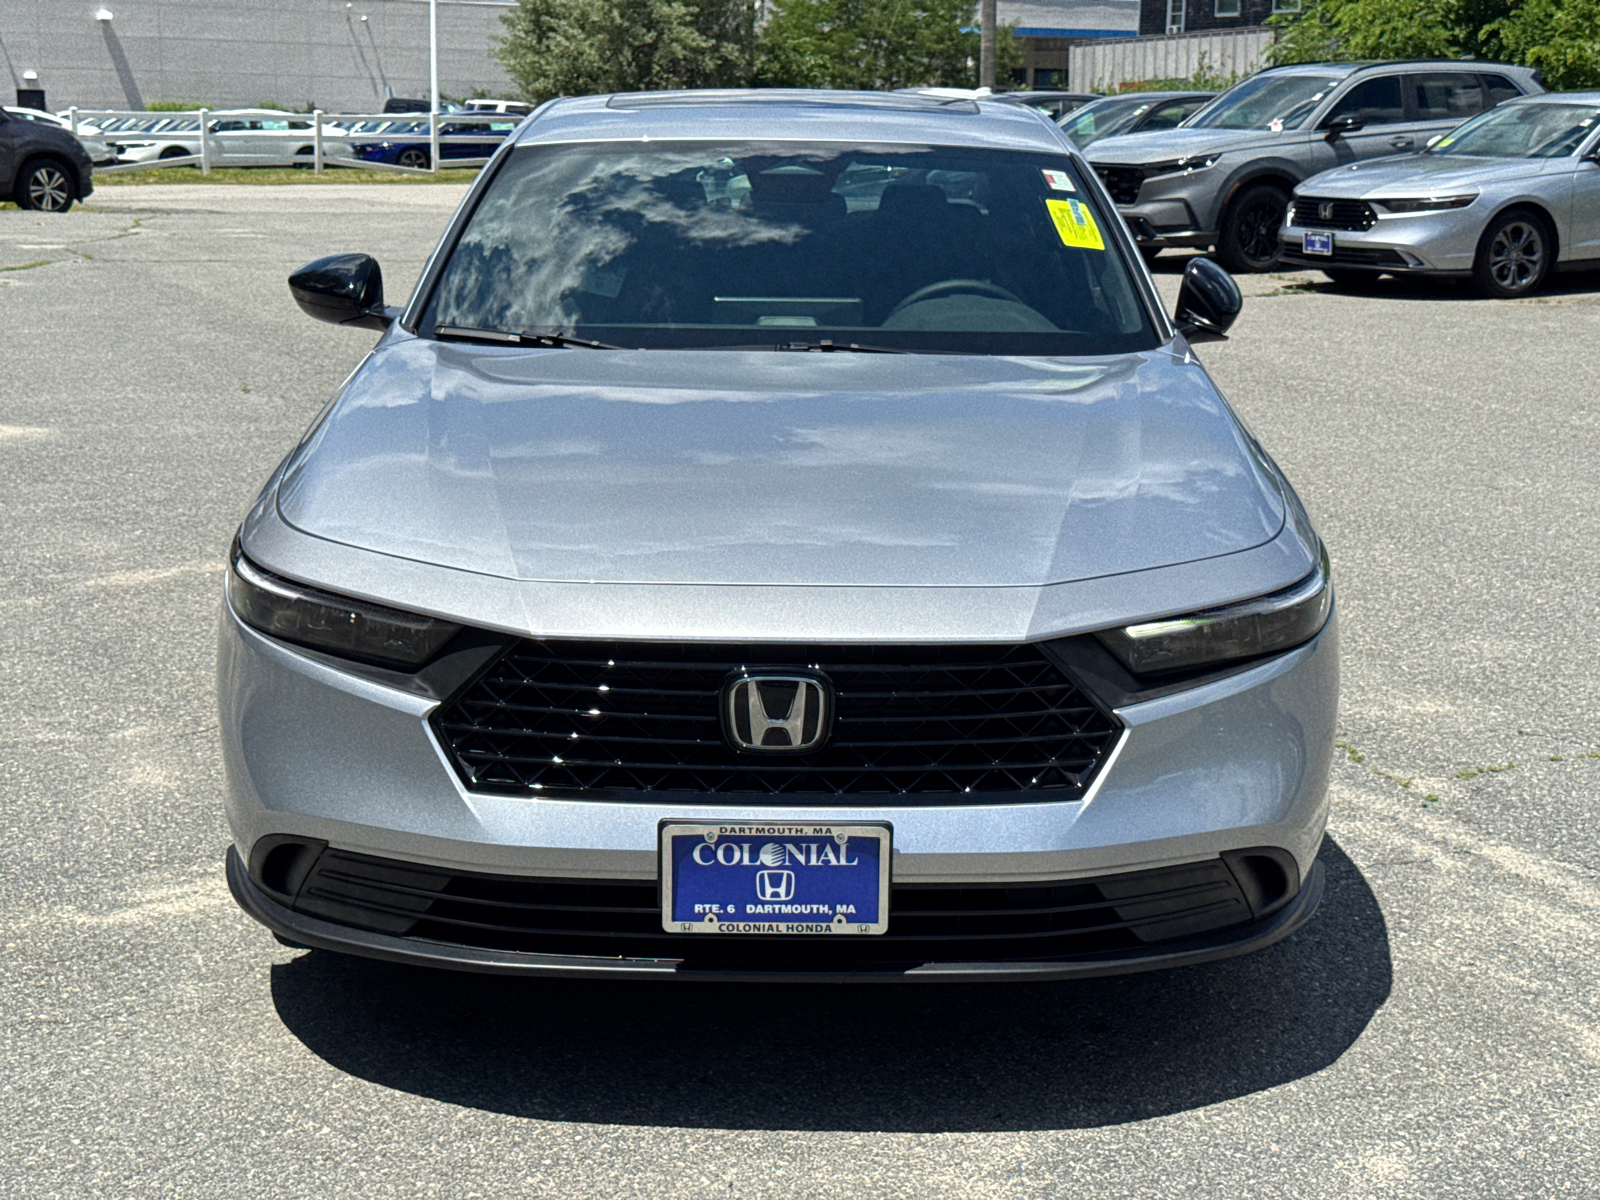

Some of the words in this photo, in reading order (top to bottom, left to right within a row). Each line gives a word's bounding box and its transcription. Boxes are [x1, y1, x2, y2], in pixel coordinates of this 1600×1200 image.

[812, 827, 833, 835] MA
[692, 842, 859, 867] COLONIAL
[694, 903, 724, 914] RTE.
[726, 903, 736, 914] 6
[746, 904, 833, 915] DARTMOUTH,
[836, 904, 857, 914] MA
[718, 923, 782, 933] COLONIAL
[786, 923, 833, 933] HONDA
